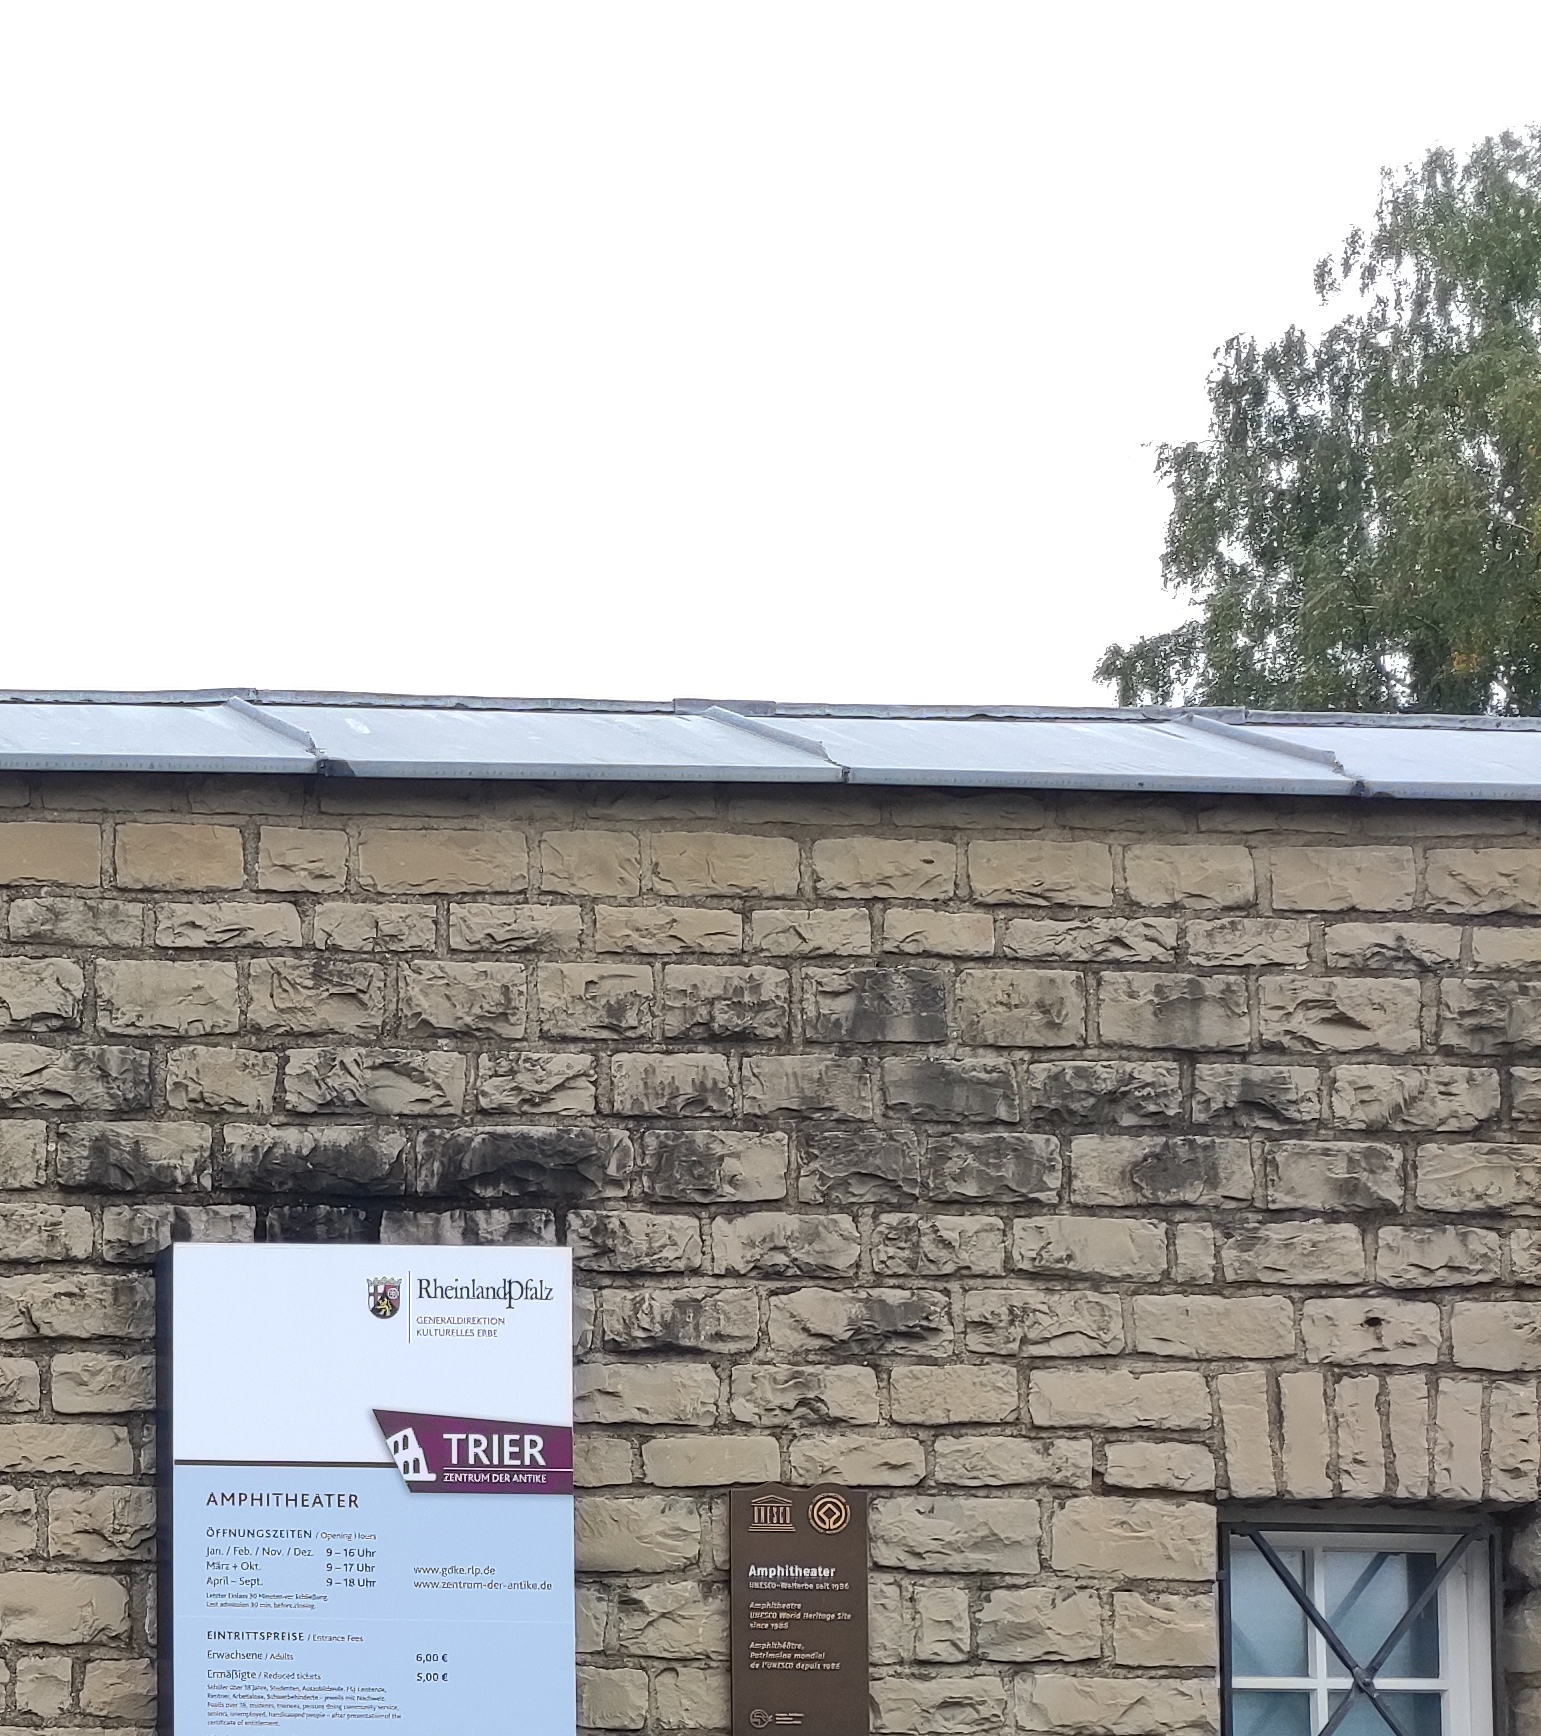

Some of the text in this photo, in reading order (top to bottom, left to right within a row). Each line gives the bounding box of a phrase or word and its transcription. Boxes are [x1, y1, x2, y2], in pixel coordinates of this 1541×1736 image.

[416, 1316, 506, 1325] GENERALDIREKTION
[416, 1328, 498, 1338] KULTURELLES ERBE
[442, 1433, 547, 1466] TRIER
[443, 1472, 547, 1484] ZENTRUM DER ANTIKE
[205, 1492, 359, 1508] AMPHITHEATER
[754, 1506, 791, 1524] UNESCO
[206, 1526, 377, 1541] ÖFFNUNGSZEITEN Opening Hours
[205, 1546, 377, 1558] Jan. Feb. Nov. Dez. 9 16 Uhr
[206, 1561, 376, 1572] März Okt. 9 17 Uhr
[413, 1565, 496, 1577] www.gdke.rlp.de
[748, 1564, 836, 1578] Amphitheater
[206, 1576, 377, 1588] April Sept. 9 18 Uhr
[413, 1580, 553, 1590] www.zentrum-der-antike.de
[207, 1631, 304, 1641] EINTRITTSPREISE
[312, 1634, 345, 1642] Entrance
[207, 1649, 448, 1664] Erwachsene Adults 6,00 €
[207, 1669, 448, 1683] Ermäßigte Reduced tickets 5,00 €
